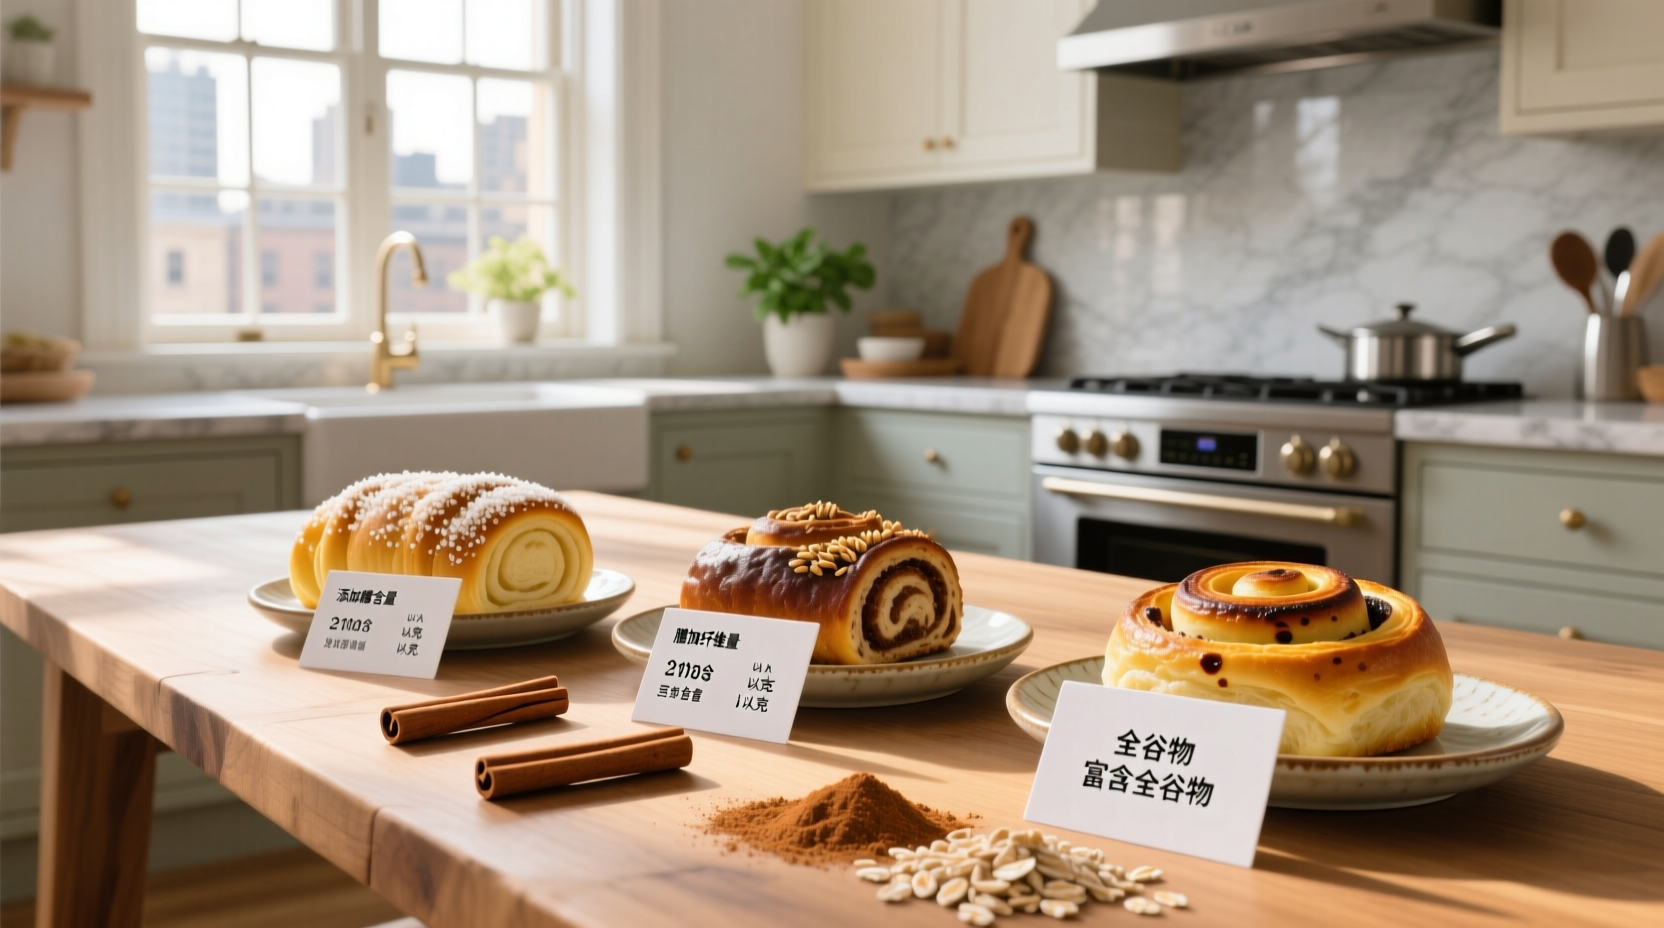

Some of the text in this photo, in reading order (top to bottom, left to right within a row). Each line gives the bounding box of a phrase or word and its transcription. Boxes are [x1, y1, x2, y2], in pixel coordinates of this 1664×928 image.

[1114, 729, 1195, 766] 全谷物
[1083, 759, 1214, 807] 富含全谷物
